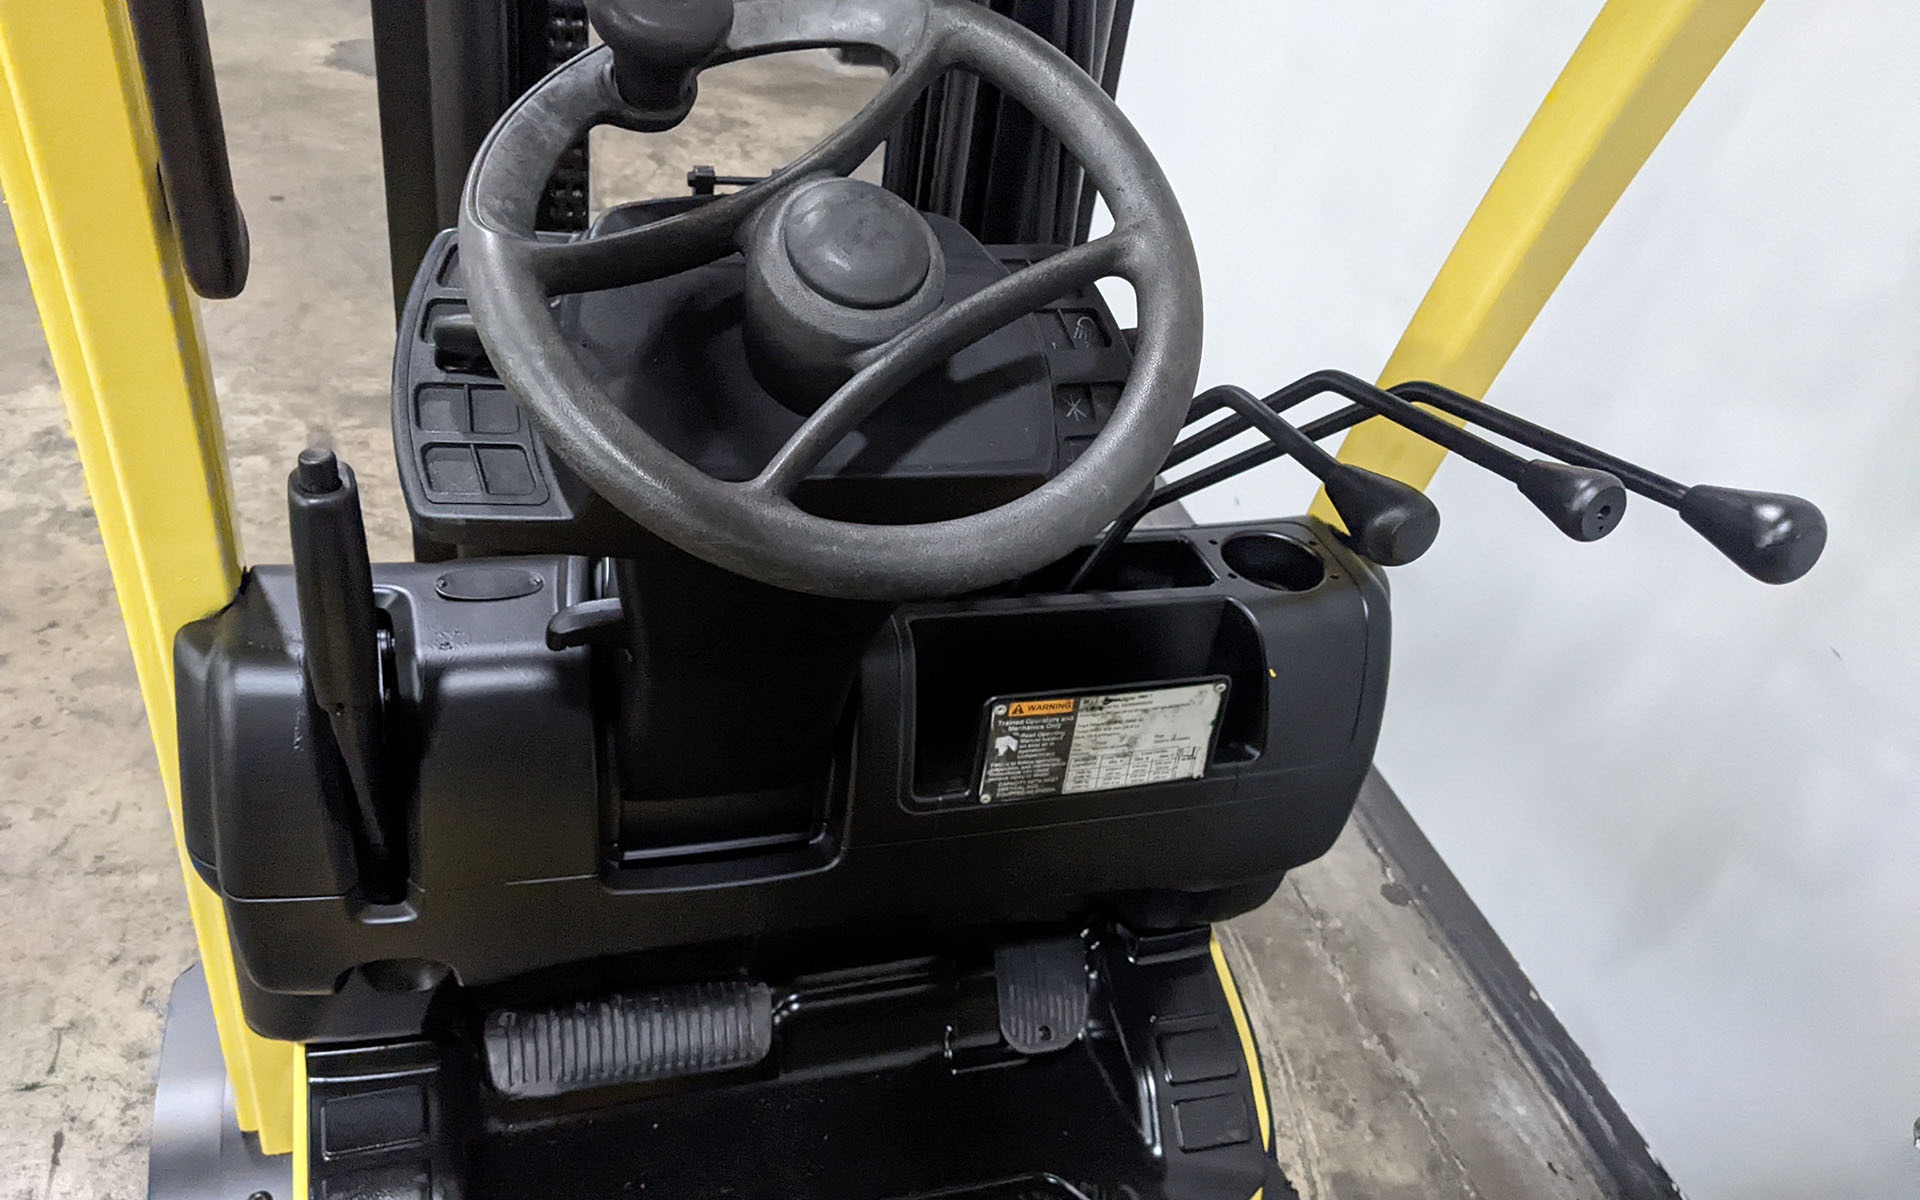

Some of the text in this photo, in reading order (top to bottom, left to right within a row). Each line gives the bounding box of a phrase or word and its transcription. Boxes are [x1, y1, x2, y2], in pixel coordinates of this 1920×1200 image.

[1027, 702, 1072, 711] WARNING
[998, 719, 1025, 727] Trained
[1046, 722, 1062, 730] Only
